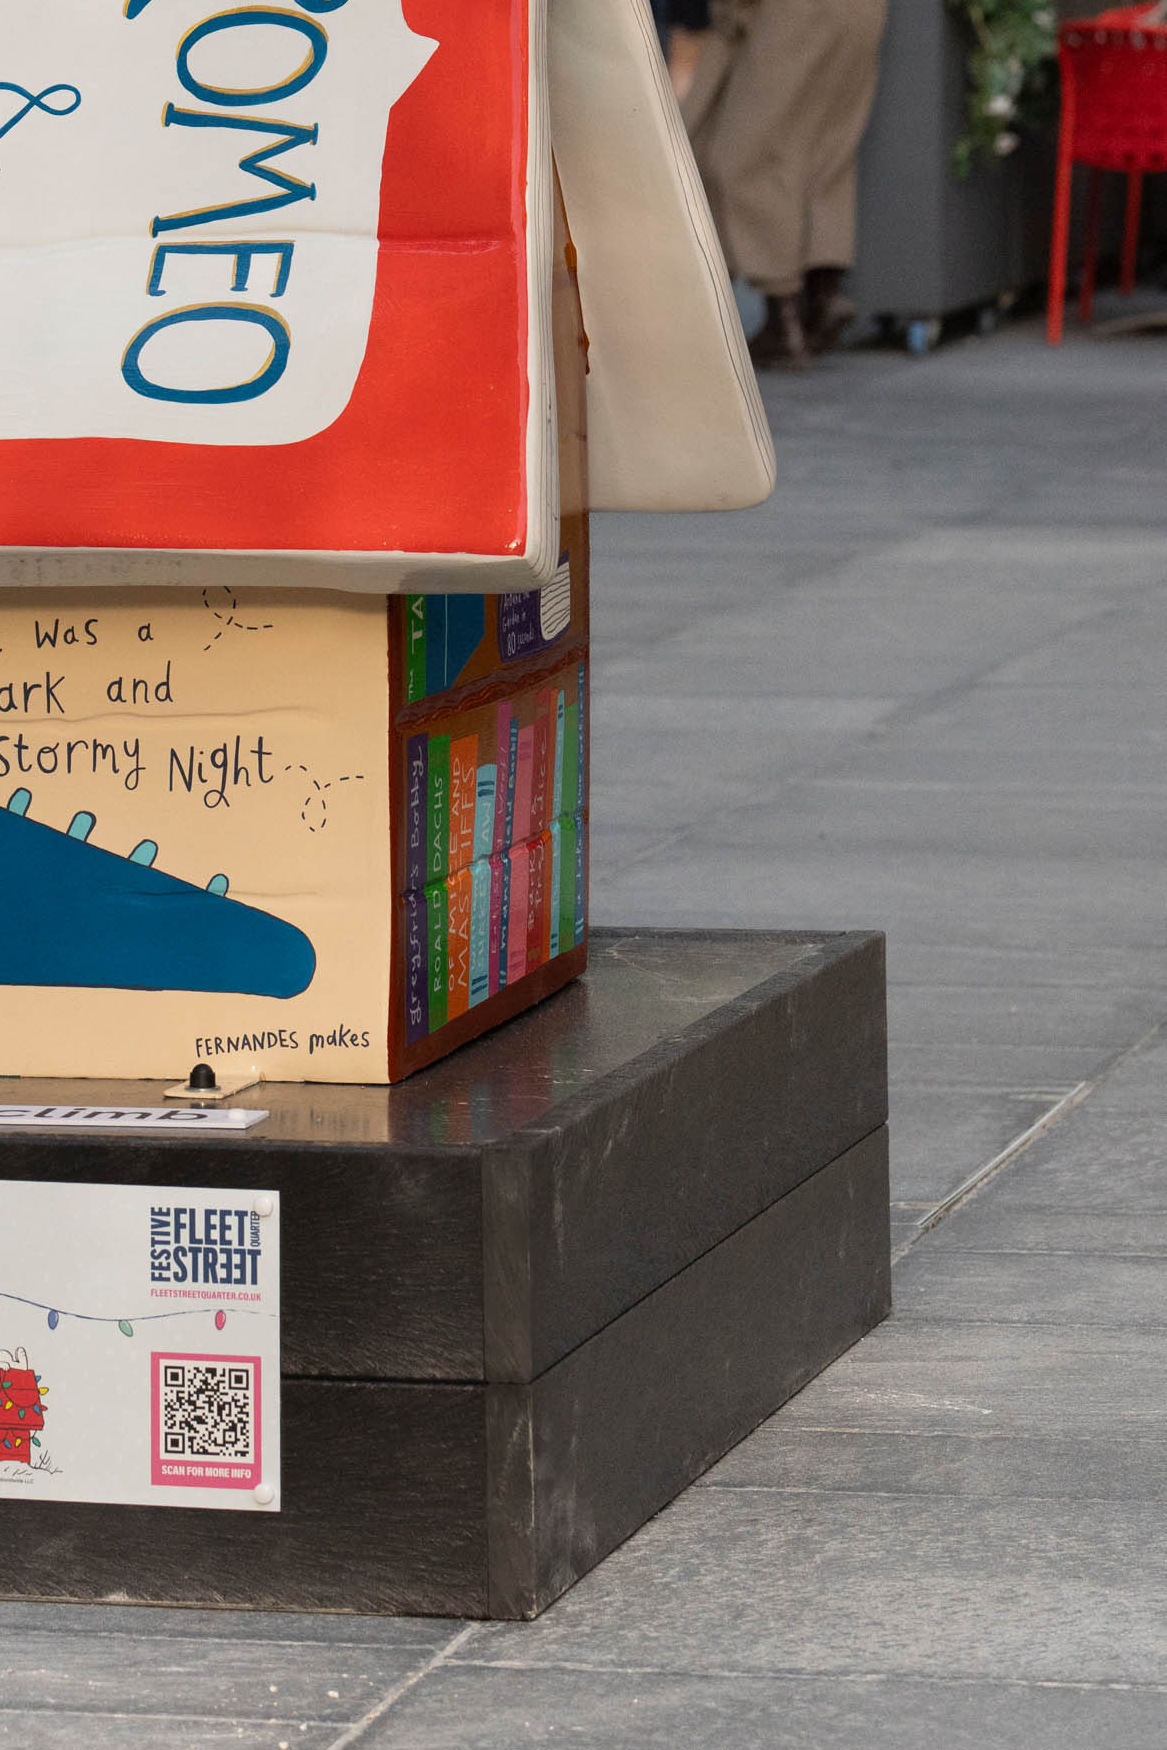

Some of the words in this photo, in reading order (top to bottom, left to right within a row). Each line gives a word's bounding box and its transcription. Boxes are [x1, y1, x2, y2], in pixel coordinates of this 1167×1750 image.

[137, 621, 154, 642] a
[506, 631, 516, 657] 80
[107, 660, 174, 703] and
[169, 735, 273, 808] Night
[451, 757, 461, 816] AND
[410, 745, 423, 848] Bobby
[432, 772, 443, 872] DACHS
[457, 760, 475, 986] MASTIFFS
[432, 890, 443, 992] ROALD
[448, 956, 456, 992] OF
[195, 1029, 298, 1057] FERNANDES
[150, 1207, 171, 1282] FESTIVE
[173, 1207, 249, 1247] FLEET
[173, 1245, 262, 1286] STREET
[150, 1288, 261, 1301] FLEETSTREETQUARTER.CO.UK
[161, 1465, 186, 1475] SCAN
[186, 1466, 204, 1476] FOR
[205, 1467, 230, 1478] MORE
[231, 1468, 252, 1479] INFO
